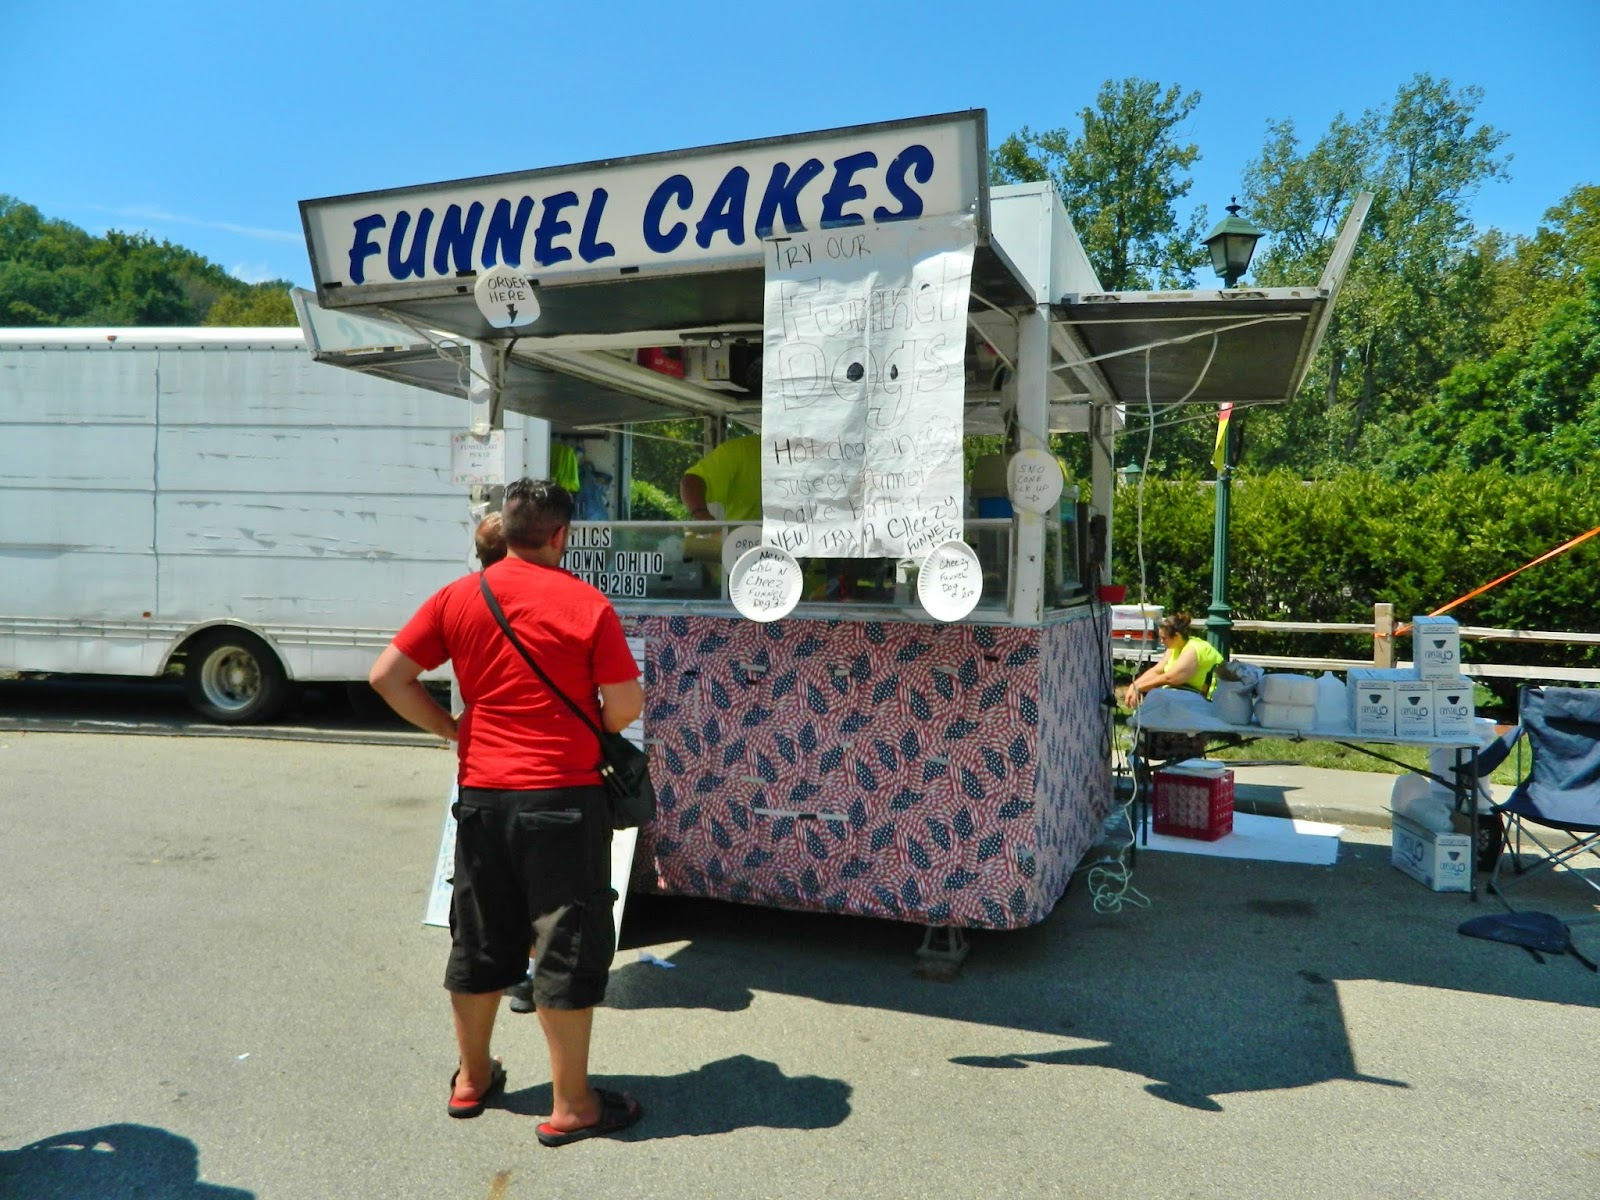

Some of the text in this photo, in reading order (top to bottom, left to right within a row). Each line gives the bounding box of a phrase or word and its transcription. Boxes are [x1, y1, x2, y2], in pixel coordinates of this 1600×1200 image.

[348, 144, 935, 286] FUNNEL CAKES
[765, 235, 871, 270] TRY OUR
[488, 276, 529, 290] ORDER
[489, 290, 526, 303] HERE
[780, 257, 963, 342] Funnel
[774, 438, 815, 466] Hot
[827, 436, 879, 474] dogs
[1018, 465, 1045, 474] SNO
[1018, 475, 1042, 483] CONE
[774, 474, 850, 499] sweet
[1036, 484, 1049, 492] UP
[783, 501, 835, 528] cake
[735, 539, 761, 549] ORDE
[770, 523, 810, 552] NEW
[863, 523, 876, 544] A
[907, 520, 955, 555] FUNNEL
[616, 552, 664, 573] OHIO
[777, 567, 787, 576] N
[599, 574, 645, 597] 9289
